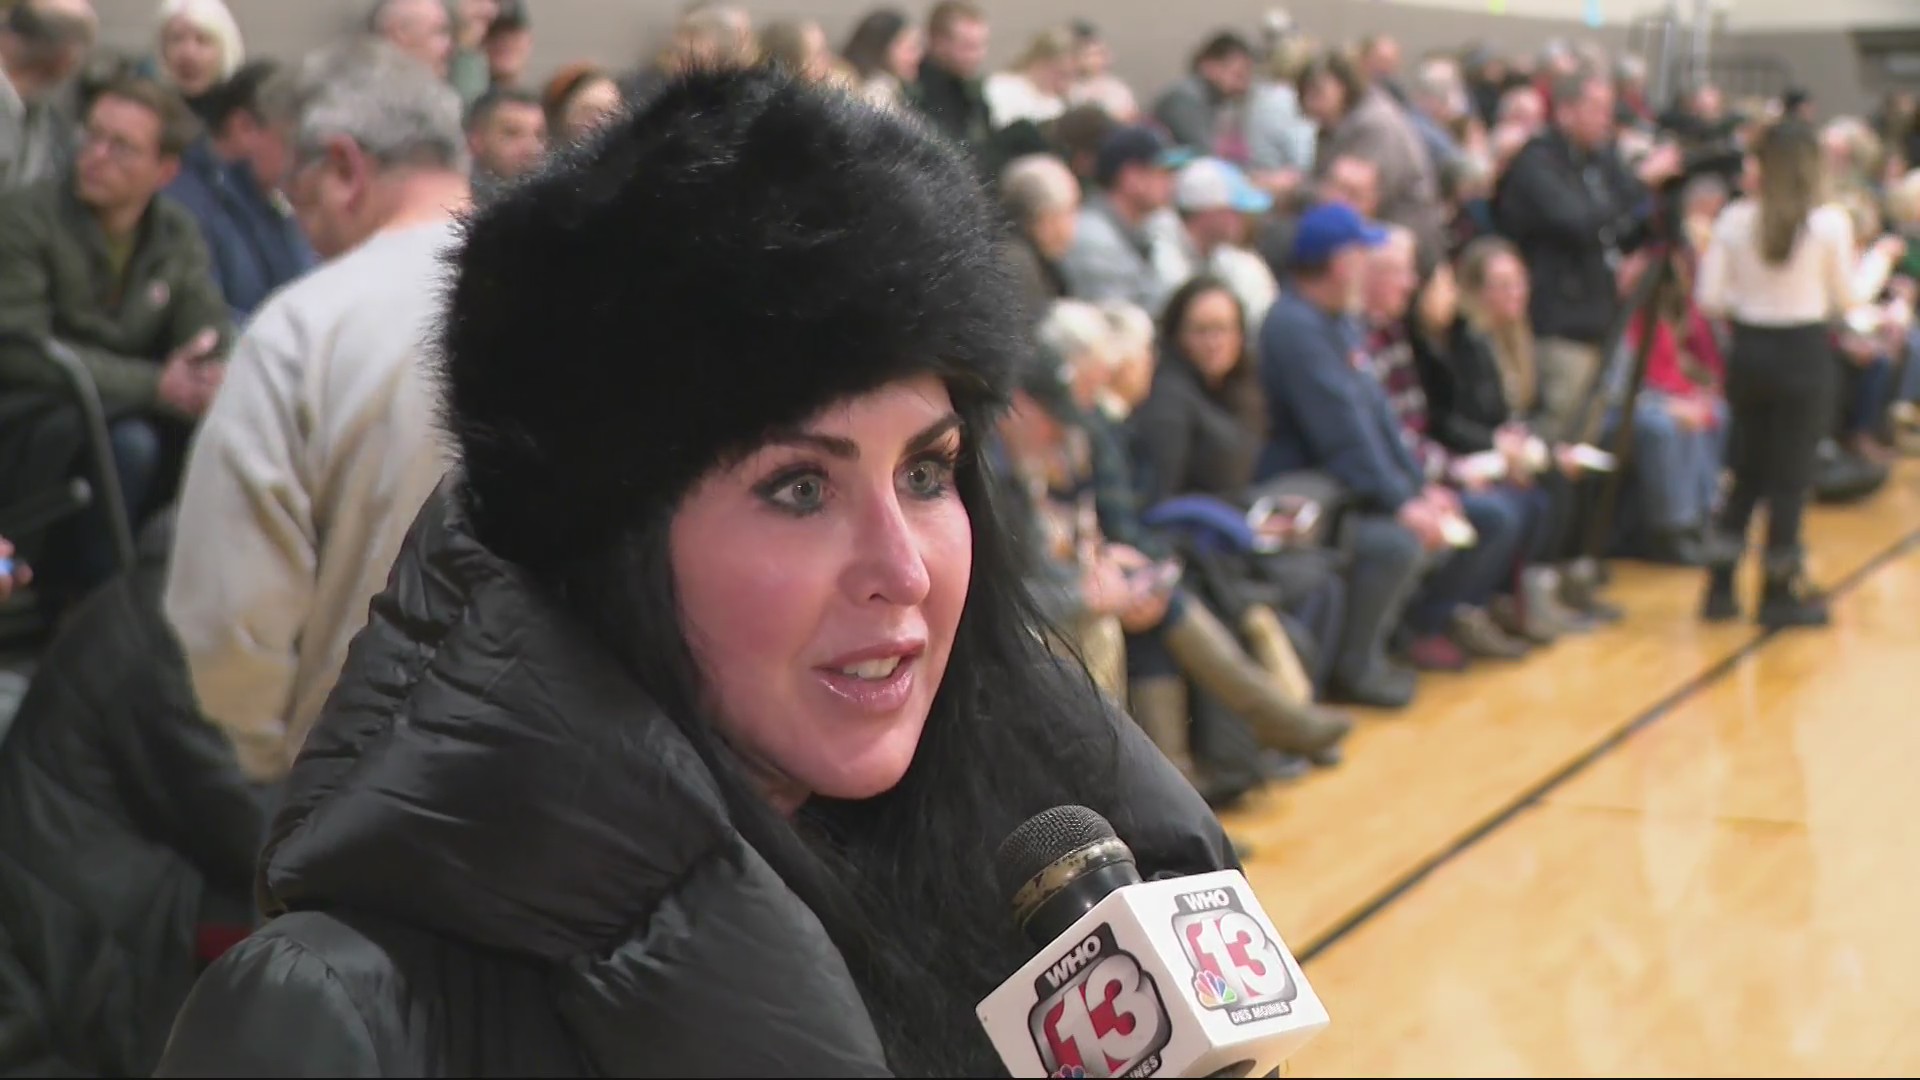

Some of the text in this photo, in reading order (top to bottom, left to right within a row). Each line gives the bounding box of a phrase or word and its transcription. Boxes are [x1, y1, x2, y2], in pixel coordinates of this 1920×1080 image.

[1183, 889, 1230, 910] WHO
[1045, 935, 1101, 988] WHO
[1195, 912, 1285, 999] 13
[1054, 954, 1158, 1077] 13
[1230, 1009, 1252, 1023] DES
